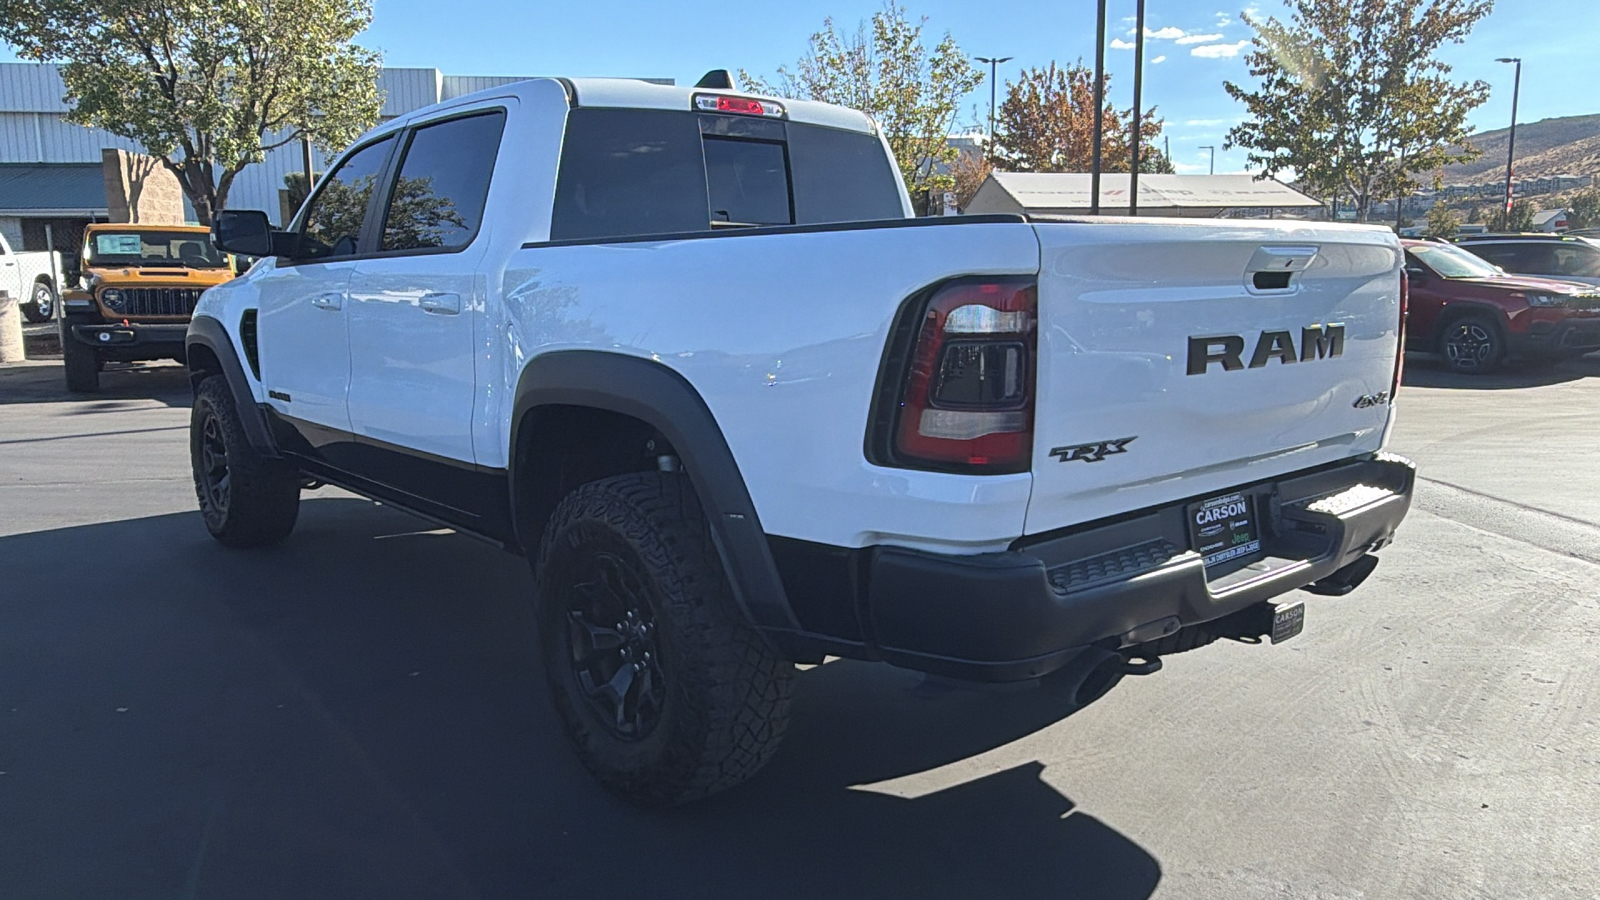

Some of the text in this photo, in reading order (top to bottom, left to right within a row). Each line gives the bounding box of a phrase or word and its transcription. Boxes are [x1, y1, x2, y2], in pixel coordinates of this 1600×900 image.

[1186, 322, 1345, 376] RAM
[1048, 435, 1139, 463] TRX
[1196, 501, 1246, 525] CARSON
[1231, 533, 1249, 545] Jeep
[1275, 607, 1303, 624] CARSON
